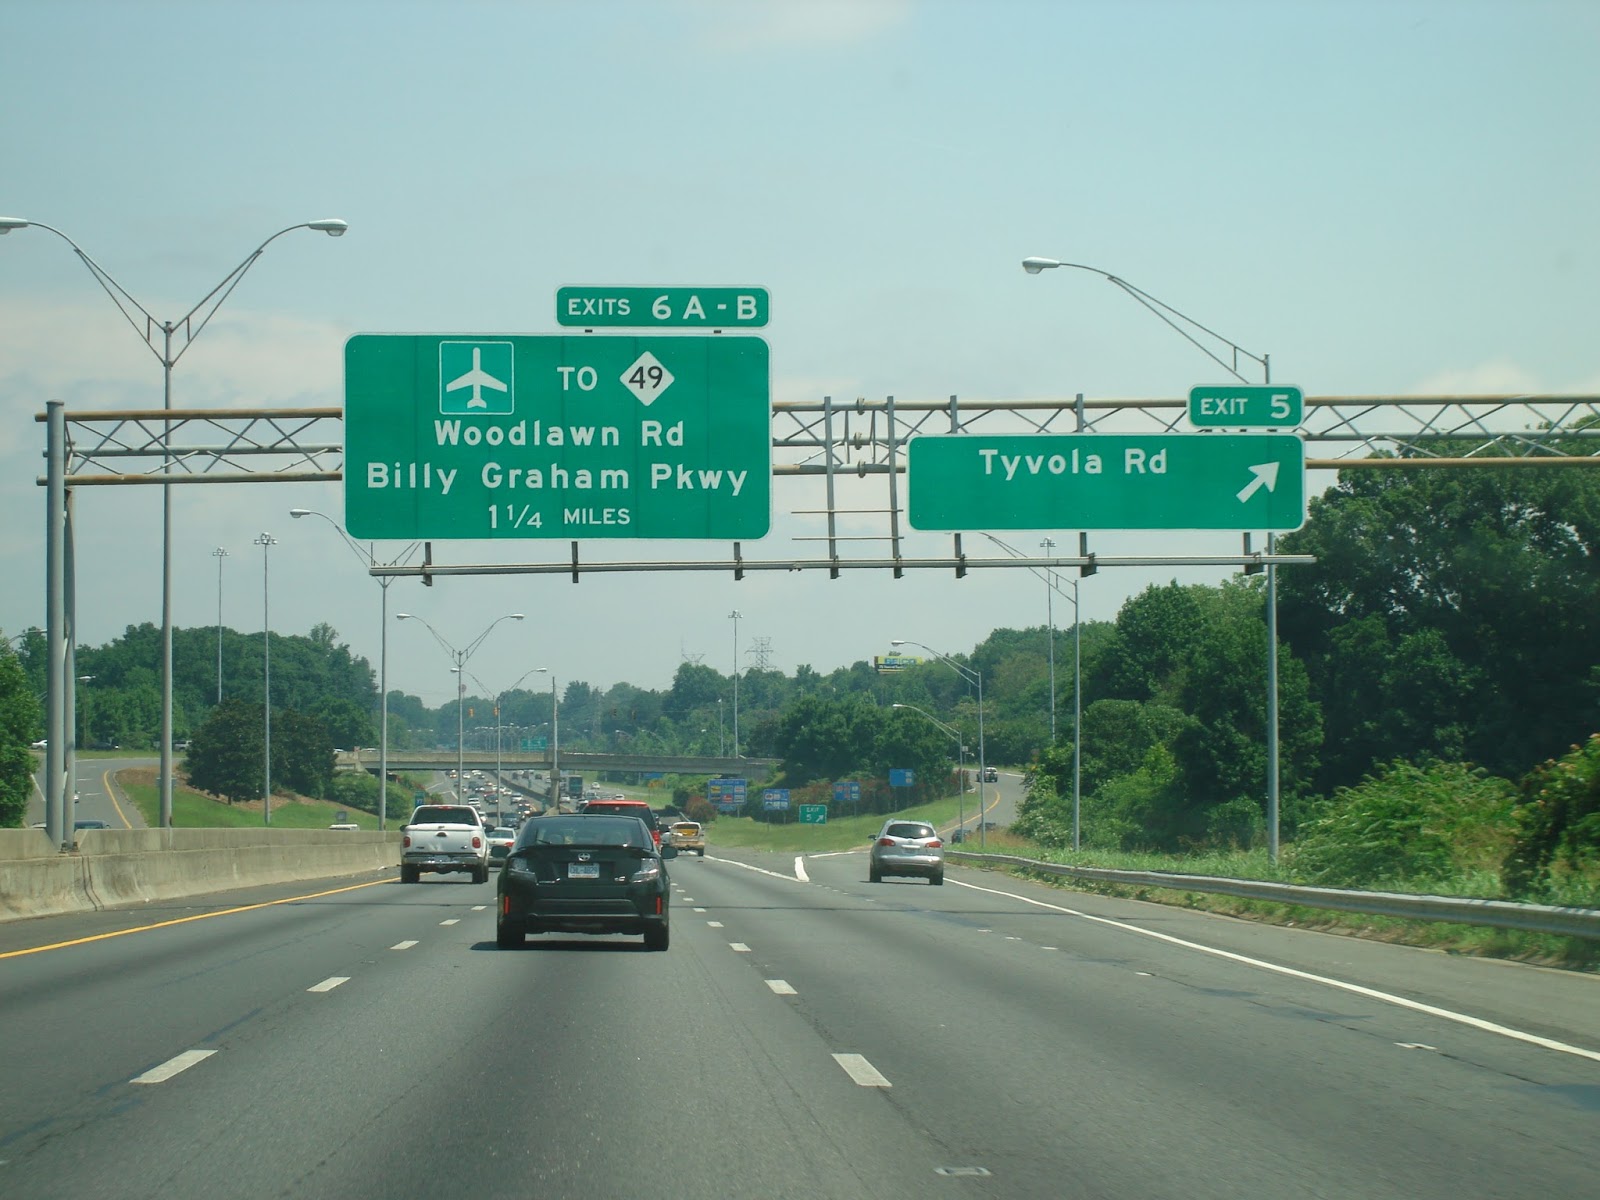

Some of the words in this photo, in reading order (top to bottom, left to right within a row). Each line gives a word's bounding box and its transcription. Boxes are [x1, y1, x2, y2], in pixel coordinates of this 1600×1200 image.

[568, 298, 631, 316] EXITS
[652, 295, 672, 320] 6
[556, 366, 598, 391] TO
[628, 366, 663, 389] 49
[1201, 398, 1248, 416] EXIT
[1271, 394, 1291, 420] 5
[434, 420, 620, 447] Woodlawn
[642, 420, 684, 447] Rd
[979, 449, 1102, 481] Tyvola
[1125, 448, 1167, 475] Rd
[367, 462, 458, 495] Billy
[481, 462, 630, 490] Graham
[651, 463, 748, 497] Pkwy
[563, 508, 631, 525] MILES
